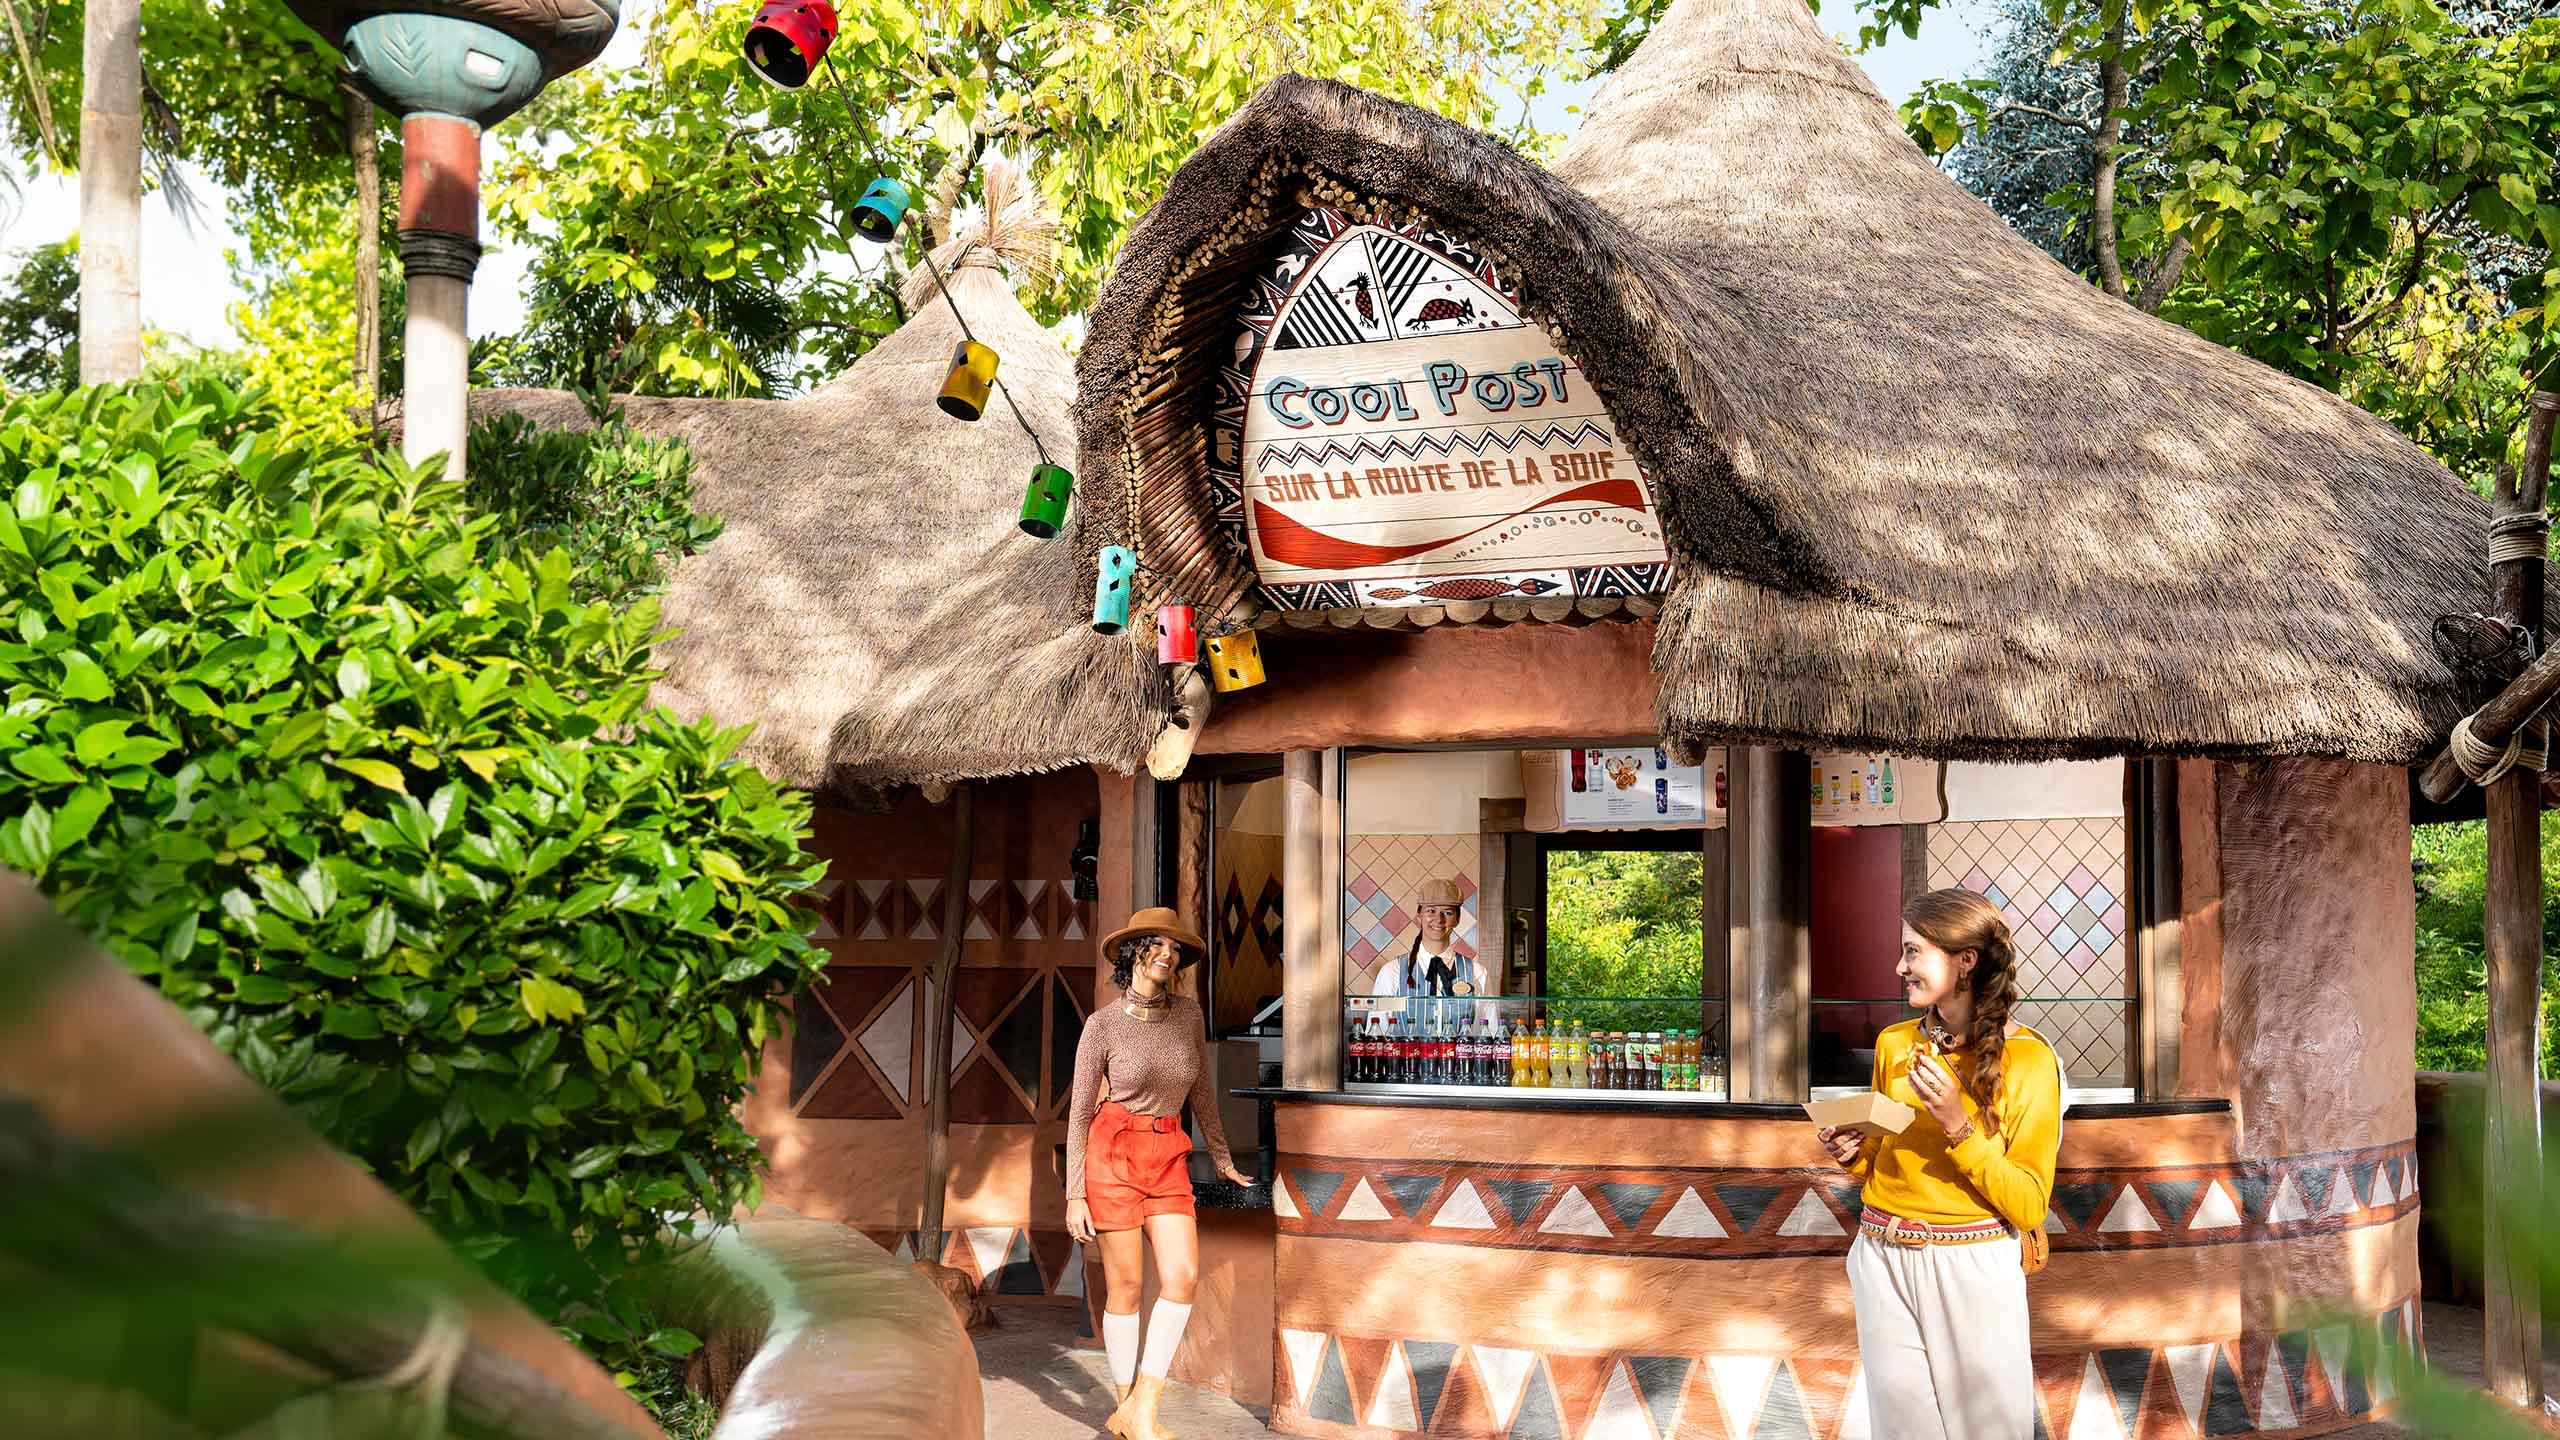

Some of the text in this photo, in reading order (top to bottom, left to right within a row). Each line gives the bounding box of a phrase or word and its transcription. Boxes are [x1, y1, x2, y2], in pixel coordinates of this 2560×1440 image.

[1264, 357, 1569, 430] COOL POST
[1264, 451, 1614, 502] SUR LA ROUTE DE LA SOIF
